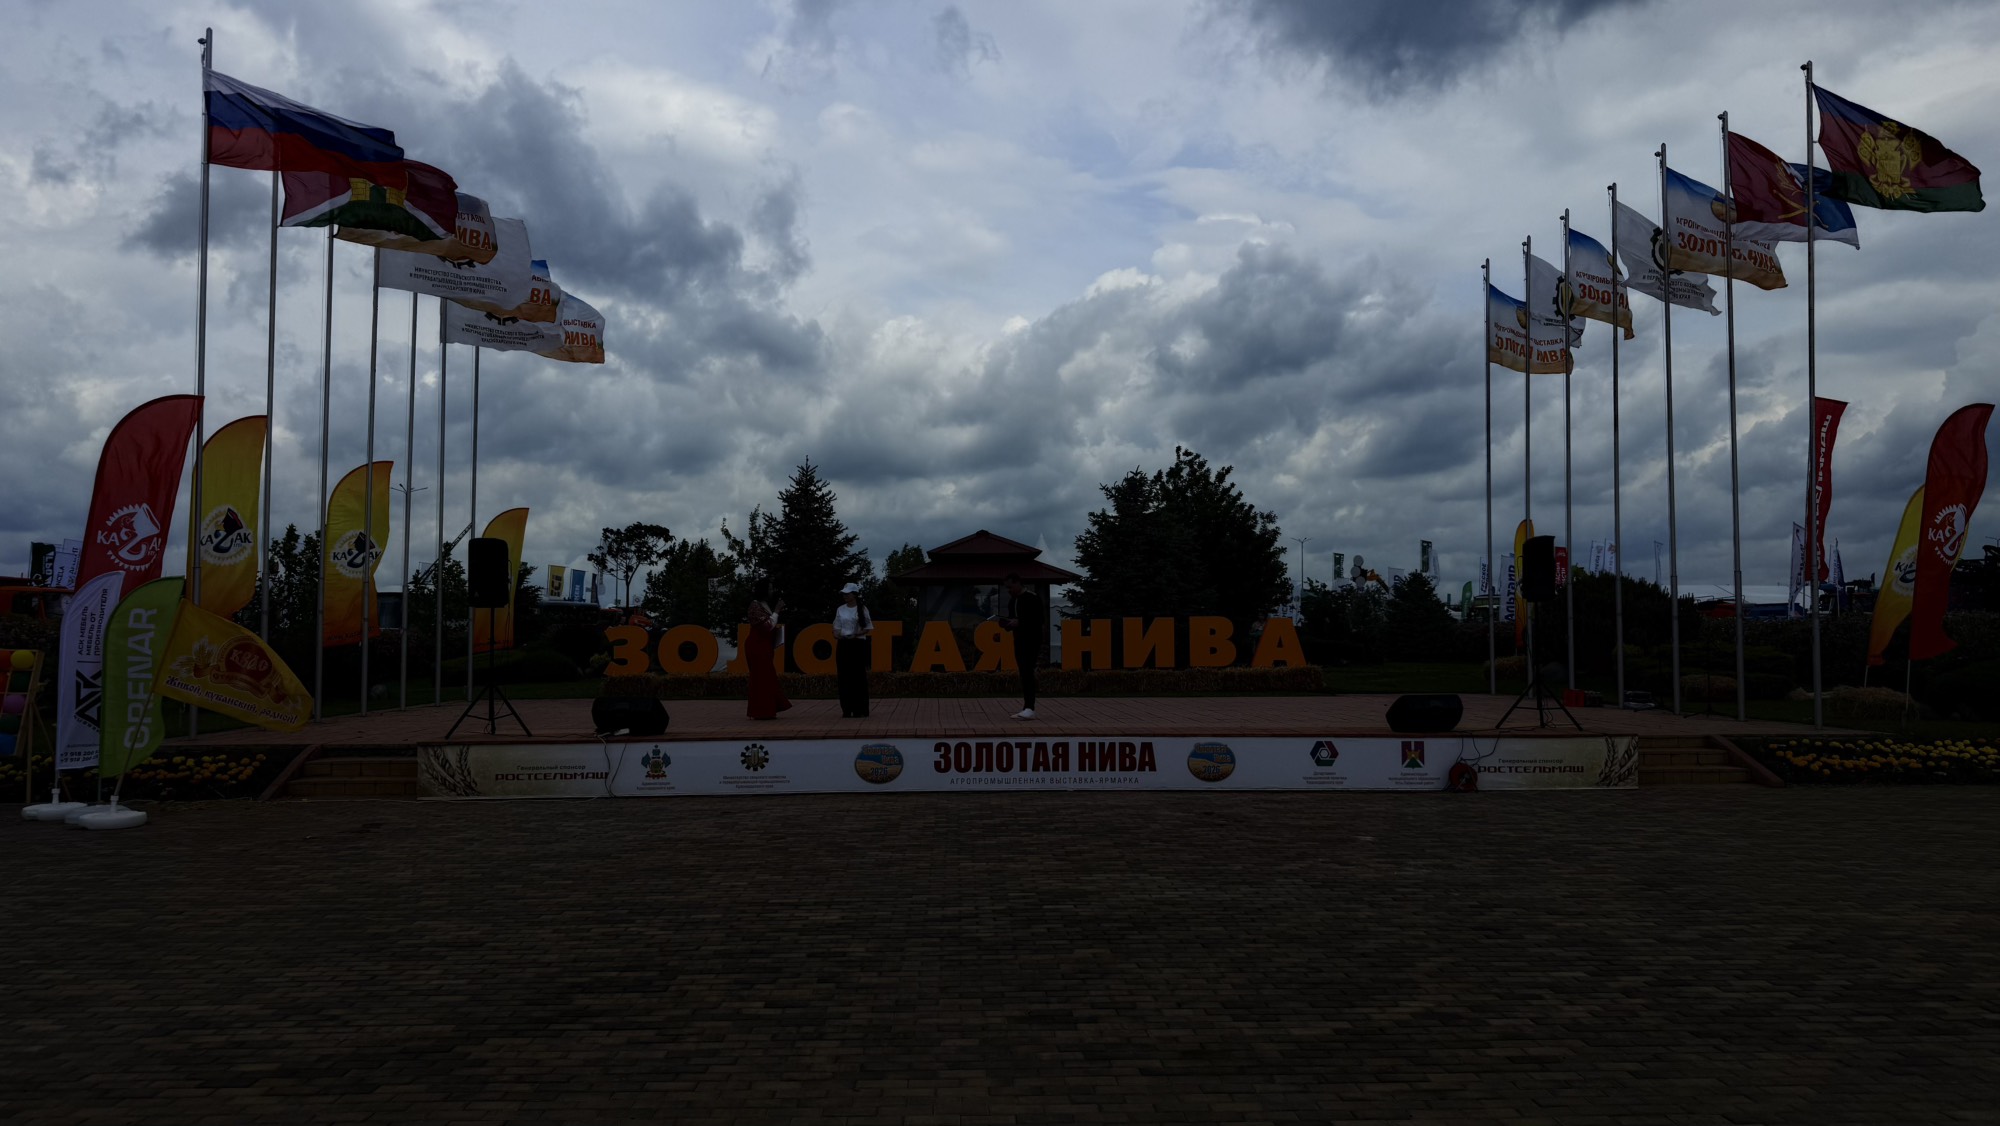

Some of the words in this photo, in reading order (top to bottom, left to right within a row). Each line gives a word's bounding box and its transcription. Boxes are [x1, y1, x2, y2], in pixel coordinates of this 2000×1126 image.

[456, 226, 492, 250] ИВА
[530, 288, 552, 305] ВА
[1061, 616, 1308, 672] НИВА
[934, 742, 1069, 772] ЗОЛОТАЯ
[1078, 742, 1157, 772] НИВА
[495, 772, 609, 781] РОСТСЕЛЬМАШ
[1478, 765, 1584, 773] РОСТСЕЛЬМАШ
[1050, 777, 1139, 785] ВЫСТАВКА-ЯРМАРКА
